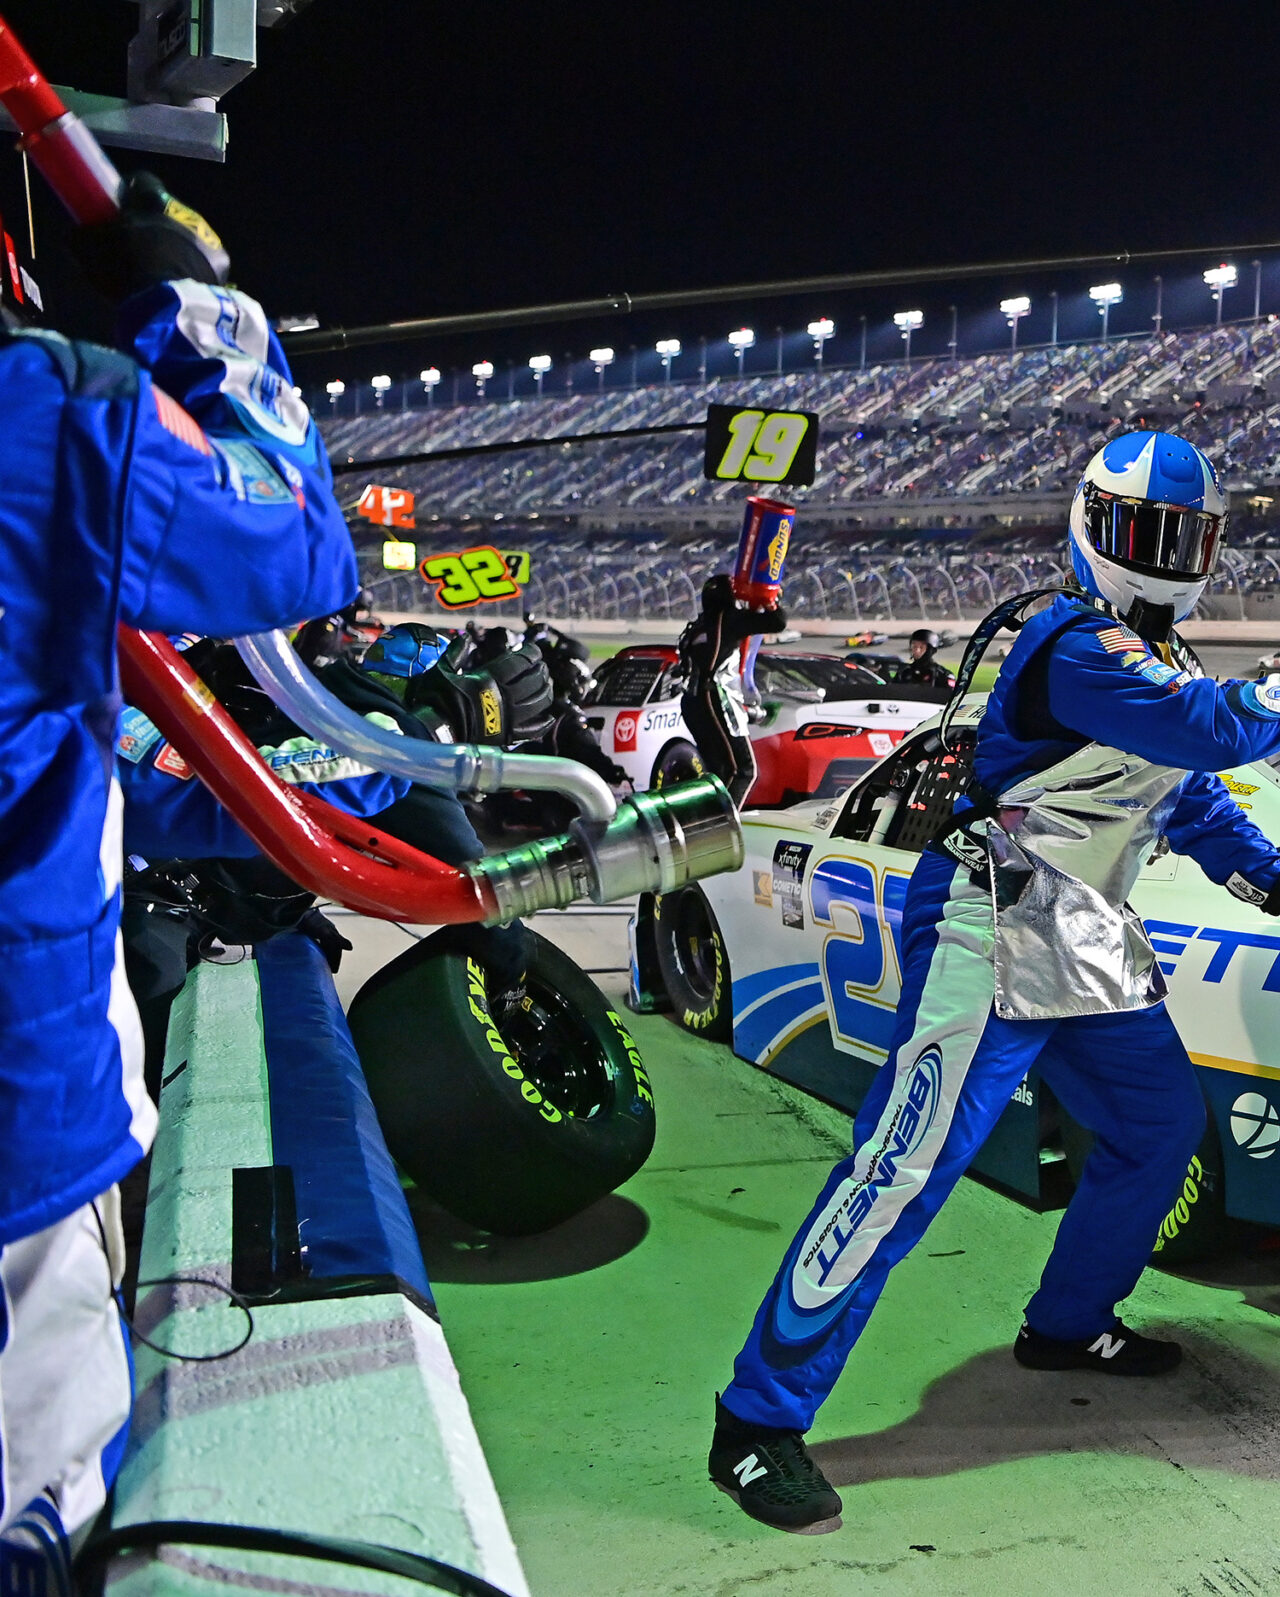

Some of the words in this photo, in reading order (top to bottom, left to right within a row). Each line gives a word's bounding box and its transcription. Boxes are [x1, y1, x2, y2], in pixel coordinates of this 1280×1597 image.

[716, 410, 808, 481] 19
[423, 548, 518, 606] 32
[606, 1011, 654, 1109] EAGLE
[817, 1066, 932, 1288] BENNETT
[849, 1103, 903, 1200] TRANSPORTATION
[802, 1209, 844, 1269] LOGISTICS
